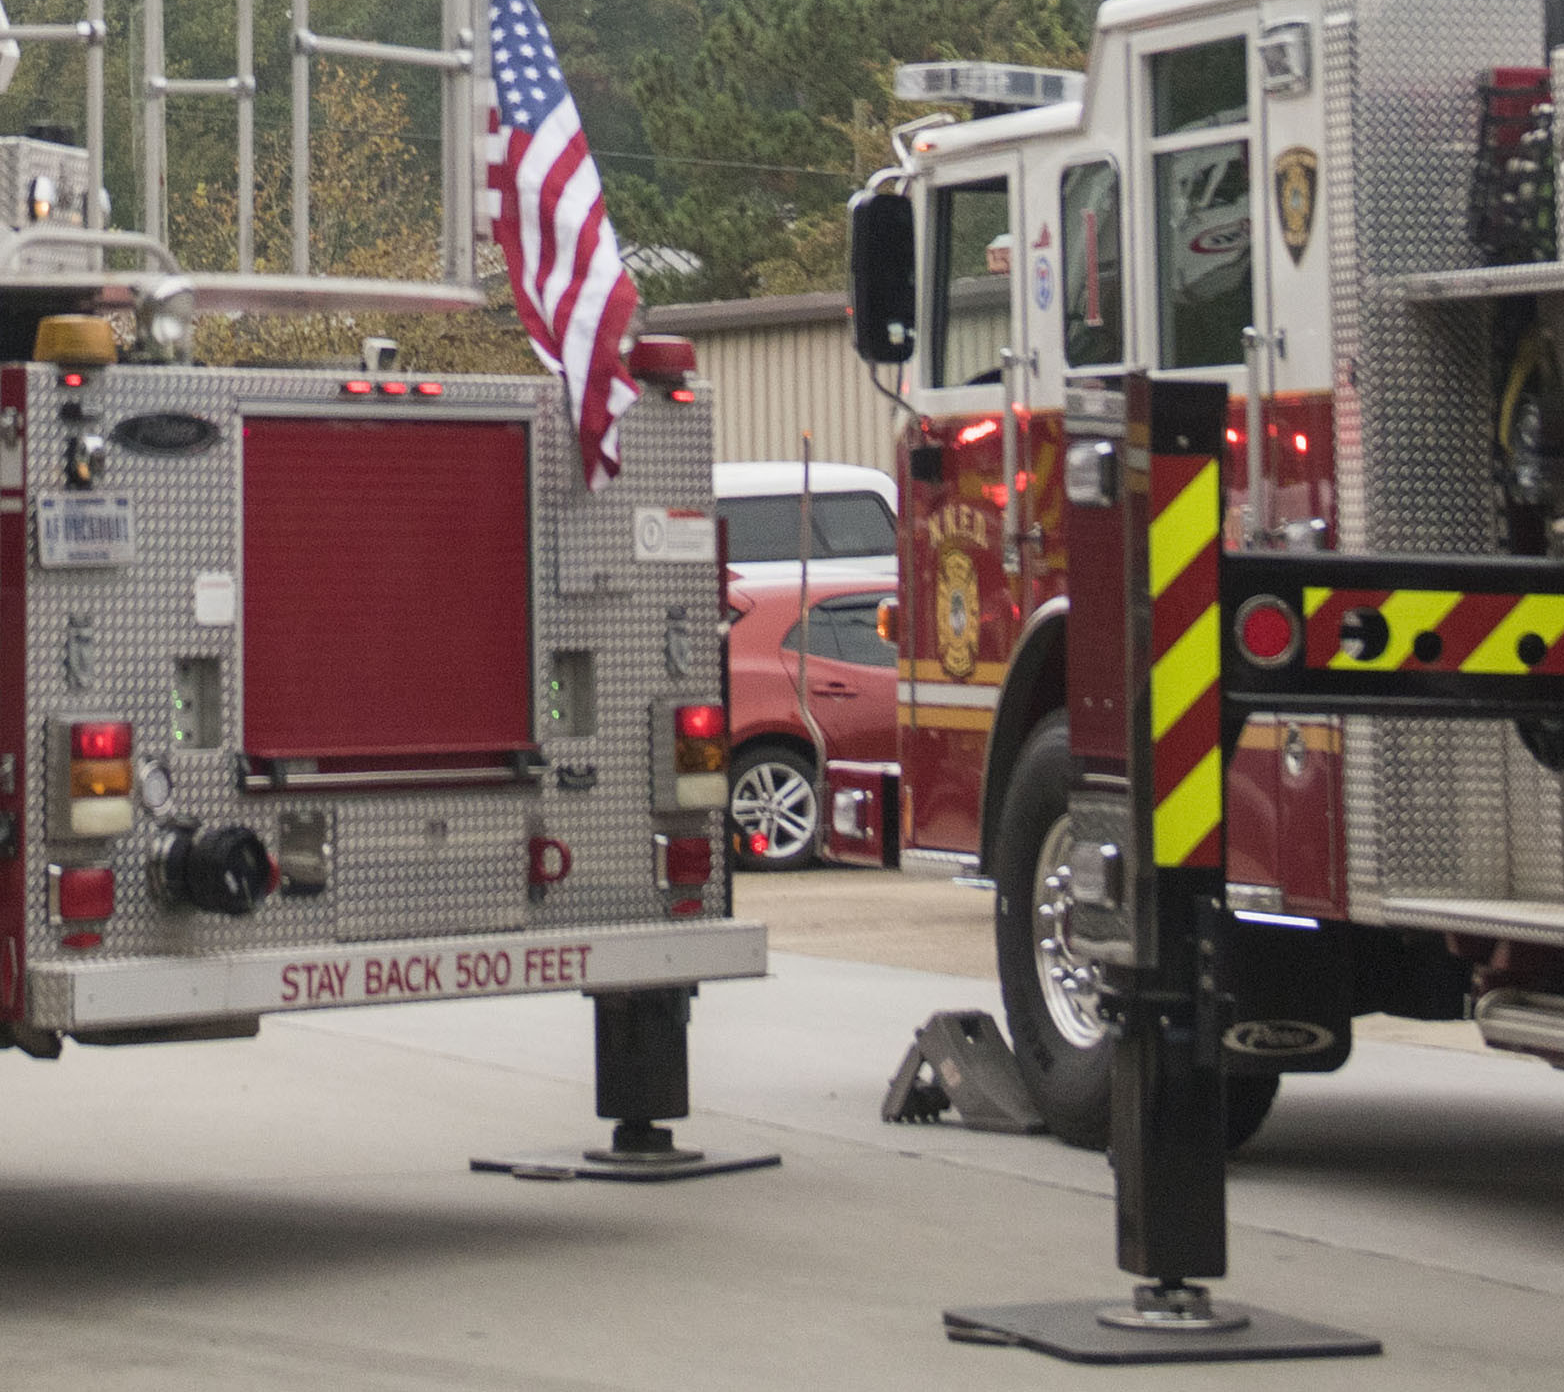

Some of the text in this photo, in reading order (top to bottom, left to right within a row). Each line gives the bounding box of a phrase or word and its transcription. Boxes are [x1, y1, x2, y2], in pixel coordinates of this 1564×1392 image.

[281, 944, 593, 1005] STAY BACK 500 FEET
